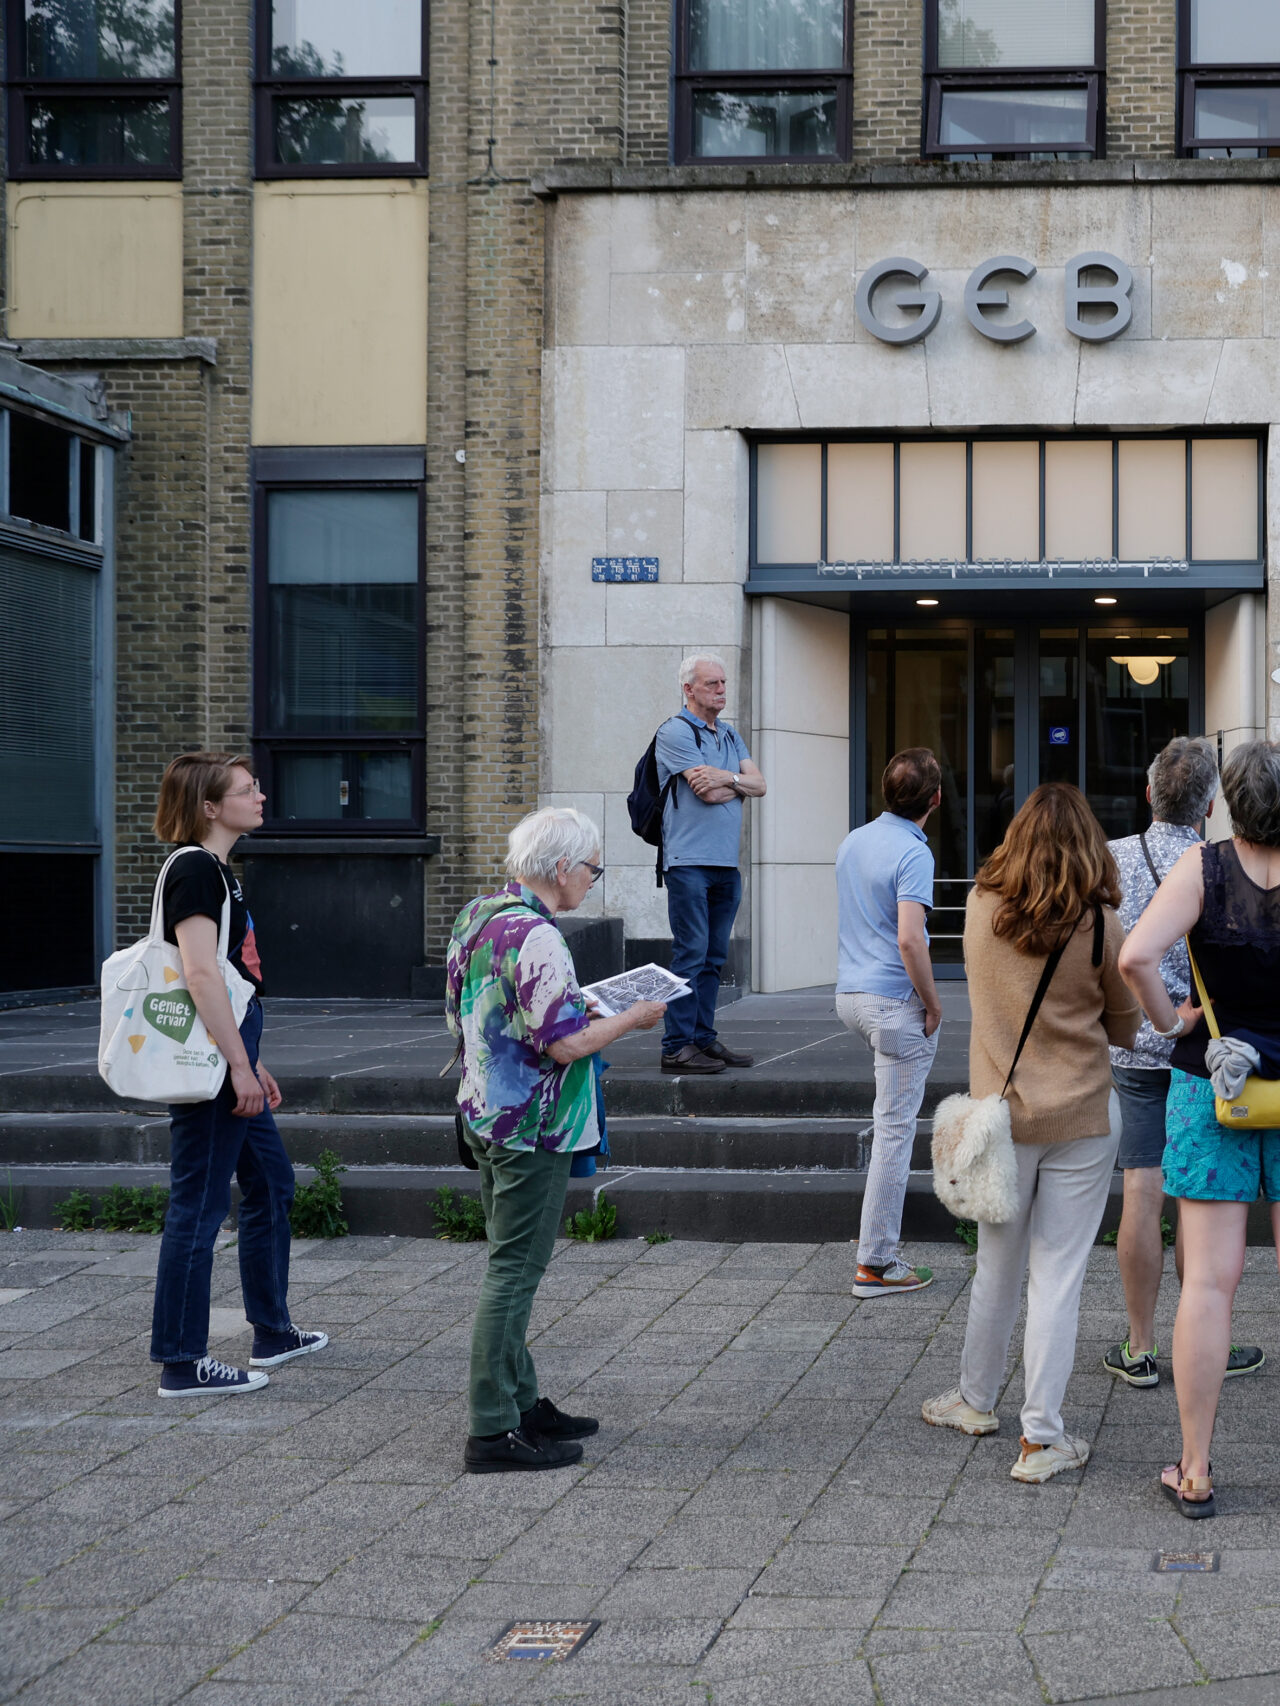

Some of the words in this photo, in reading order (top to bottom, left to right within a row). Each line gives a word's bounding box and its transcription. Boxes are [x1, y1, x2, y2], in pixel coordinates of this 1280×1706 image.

[855, 250, 1134, 346] GEB
[816, 556, 1065, 576] ROCHUSSENSTRAAT
[150, 997, 192, 1016] Geniet
[156, 1014, 187, 1027] ervan
